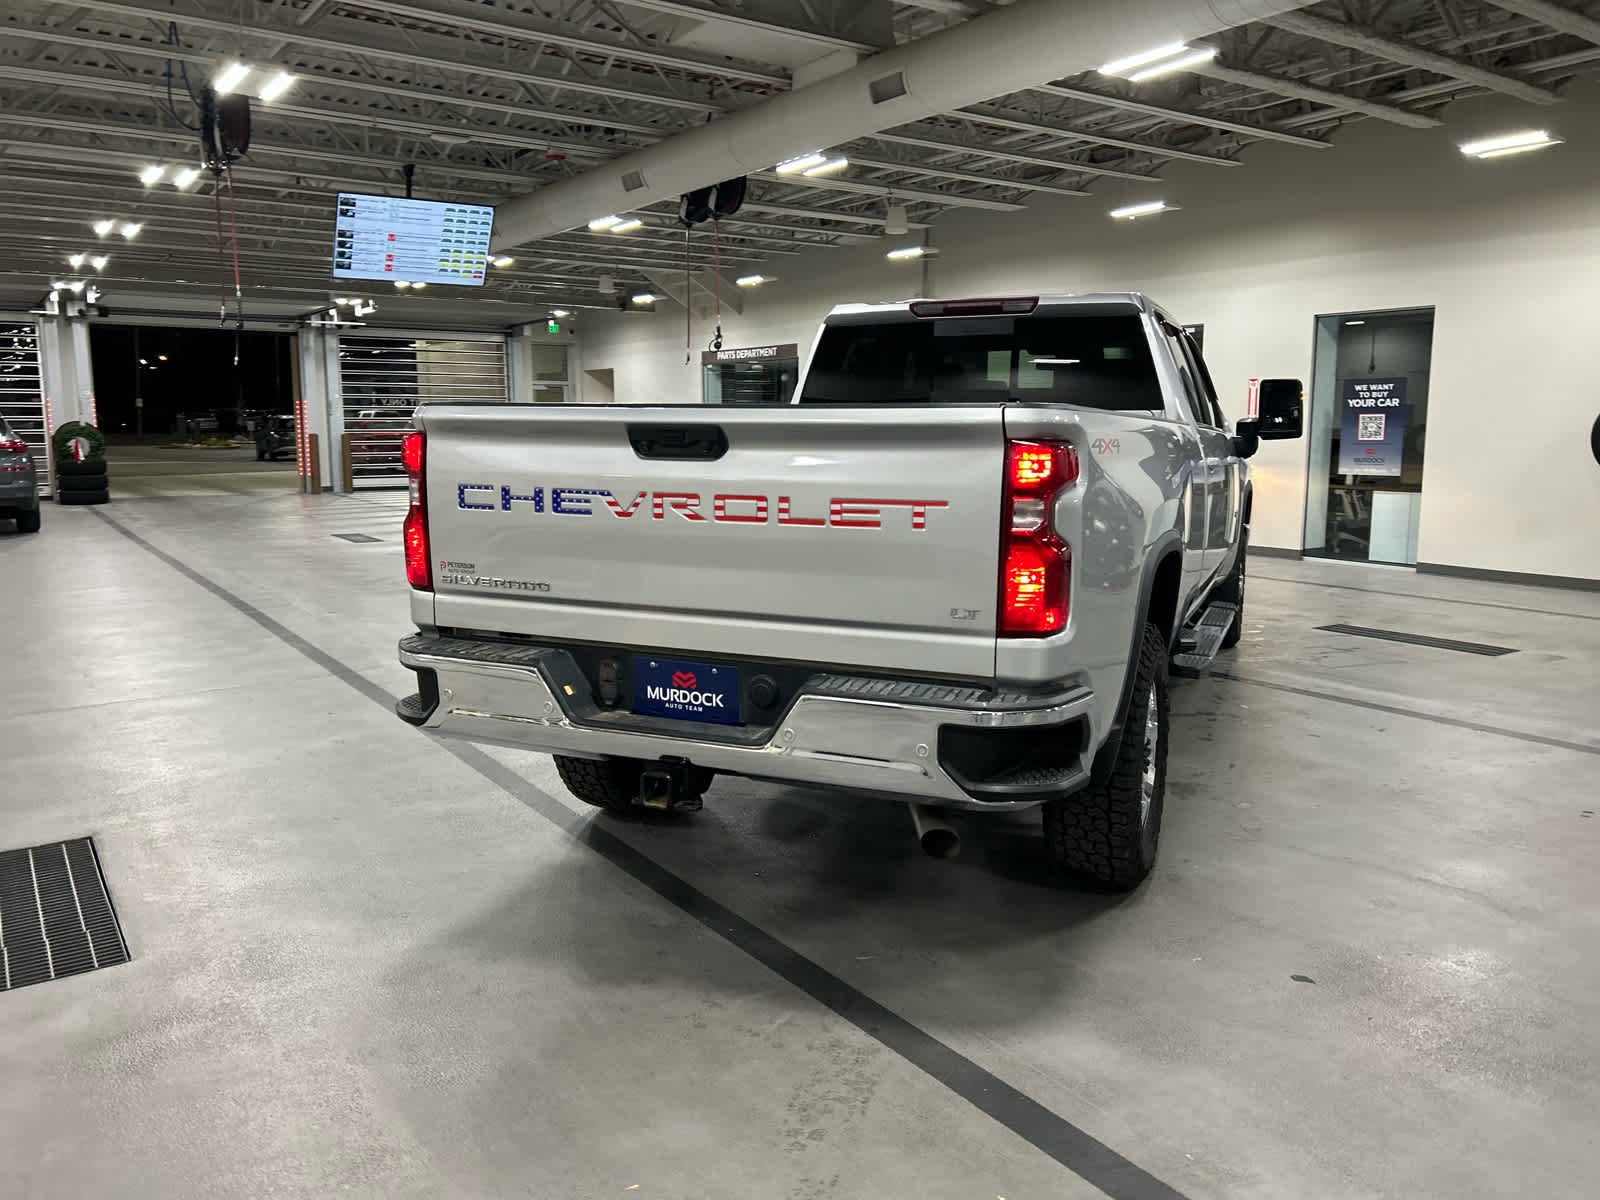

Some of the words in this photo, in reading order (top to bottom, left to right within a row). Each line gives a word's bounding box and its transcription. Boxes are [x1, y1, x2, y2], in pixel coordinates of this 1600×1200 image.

[717, 350, 736, 360] PARTS
[736, 347, 777, 359] DEPARTMENT
[1369, 383, 1395, 391] WANT
[1348, 398, 1376, 408] YOUR
[1377, 398, 1400, 407] CAR
[457, 483, 950, 532] CHEVROLET
[447, 561, 475, 569] PETERSON
[442, 575, 551, 592] SILVERADO
[647, 685, 724, 708] MURDOCK
[665, 702, 683, 710] AUTO
[685, 704, 703, 712] TEAM
